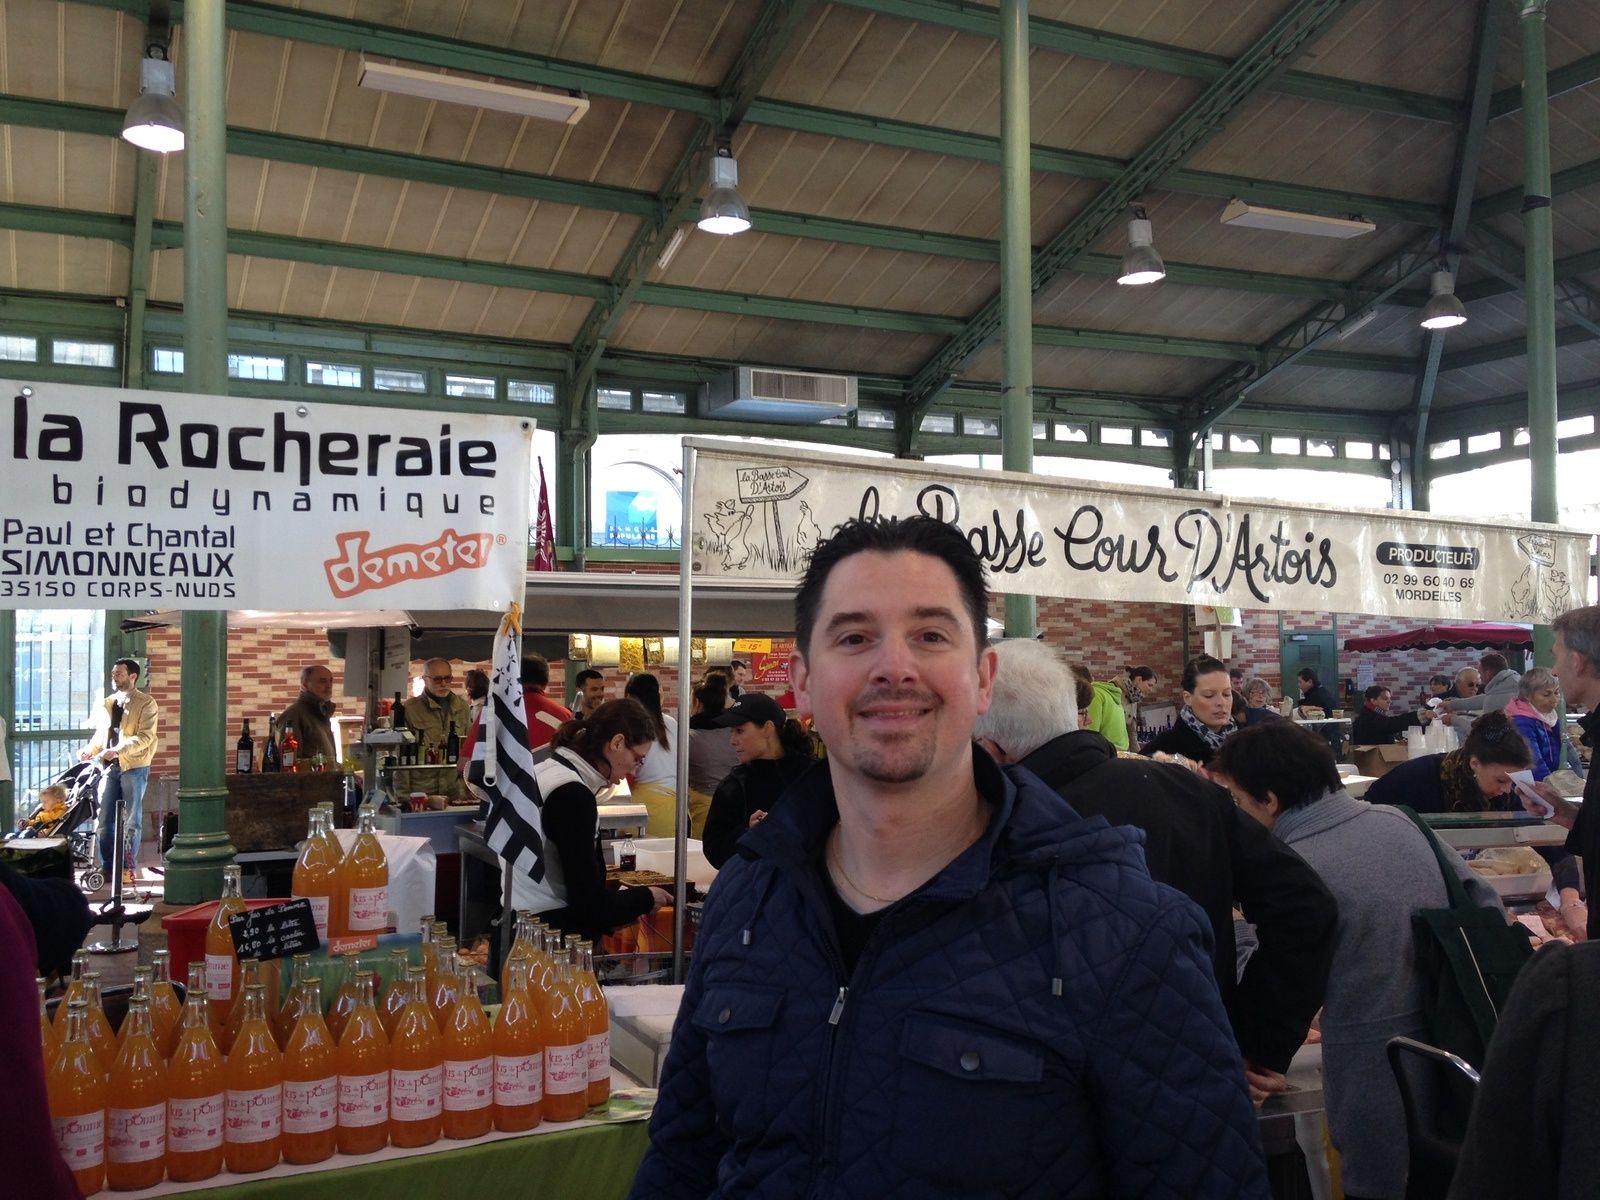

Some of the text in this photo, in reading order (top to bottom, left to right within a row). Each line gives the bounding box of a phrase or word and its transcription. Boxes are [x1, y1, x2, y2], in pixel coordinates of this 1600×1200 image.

[13, 396, 497, 486] la Rocheraie
[53, 474, 495, 519] biodynamique
[3, 518, 235, 551] Paul et Chantal
[1, 550, 234, 577] SIMONNEAUX
[329, 535, 492, 592] demeter
[1054, 505, 1178, 583] Cour
[1175, 508, 1337, 604] D'Artois
[1388, 547, 1473, 565] PRODUCTEUR
[1, 580, 236, 598] 35150 CORPS-NUDS
[1383, 573, 1475, 588] 02 99 60 40 69
[1395, 589, 1462, 602] MORDELLES
